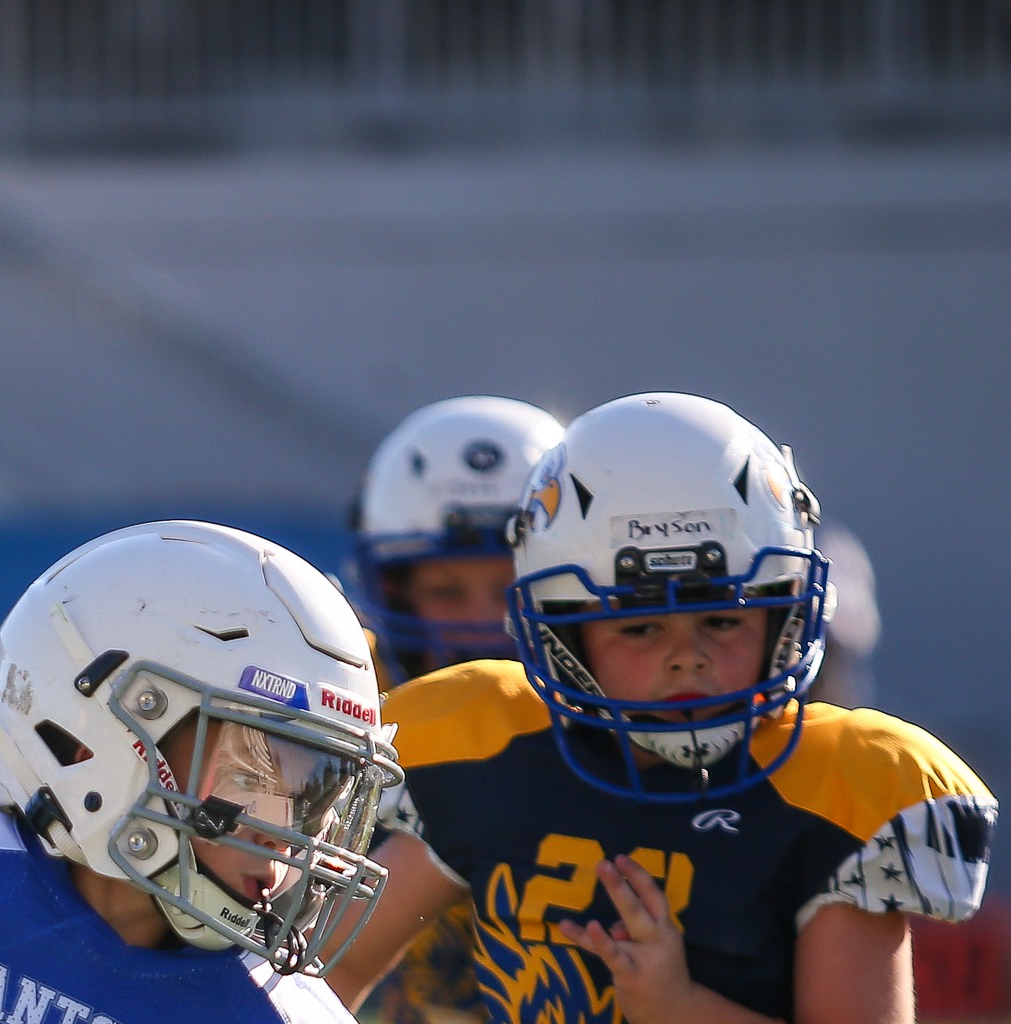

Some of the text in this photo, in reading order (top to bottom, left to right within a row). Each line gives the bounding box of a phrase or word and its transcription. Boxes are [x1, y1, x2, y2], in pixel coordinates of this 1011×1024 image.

[628, 518, 712, 539] Bryson
[251, 669, 298, 699] NXTRND
[320, 687, 377, 726] Riddell
